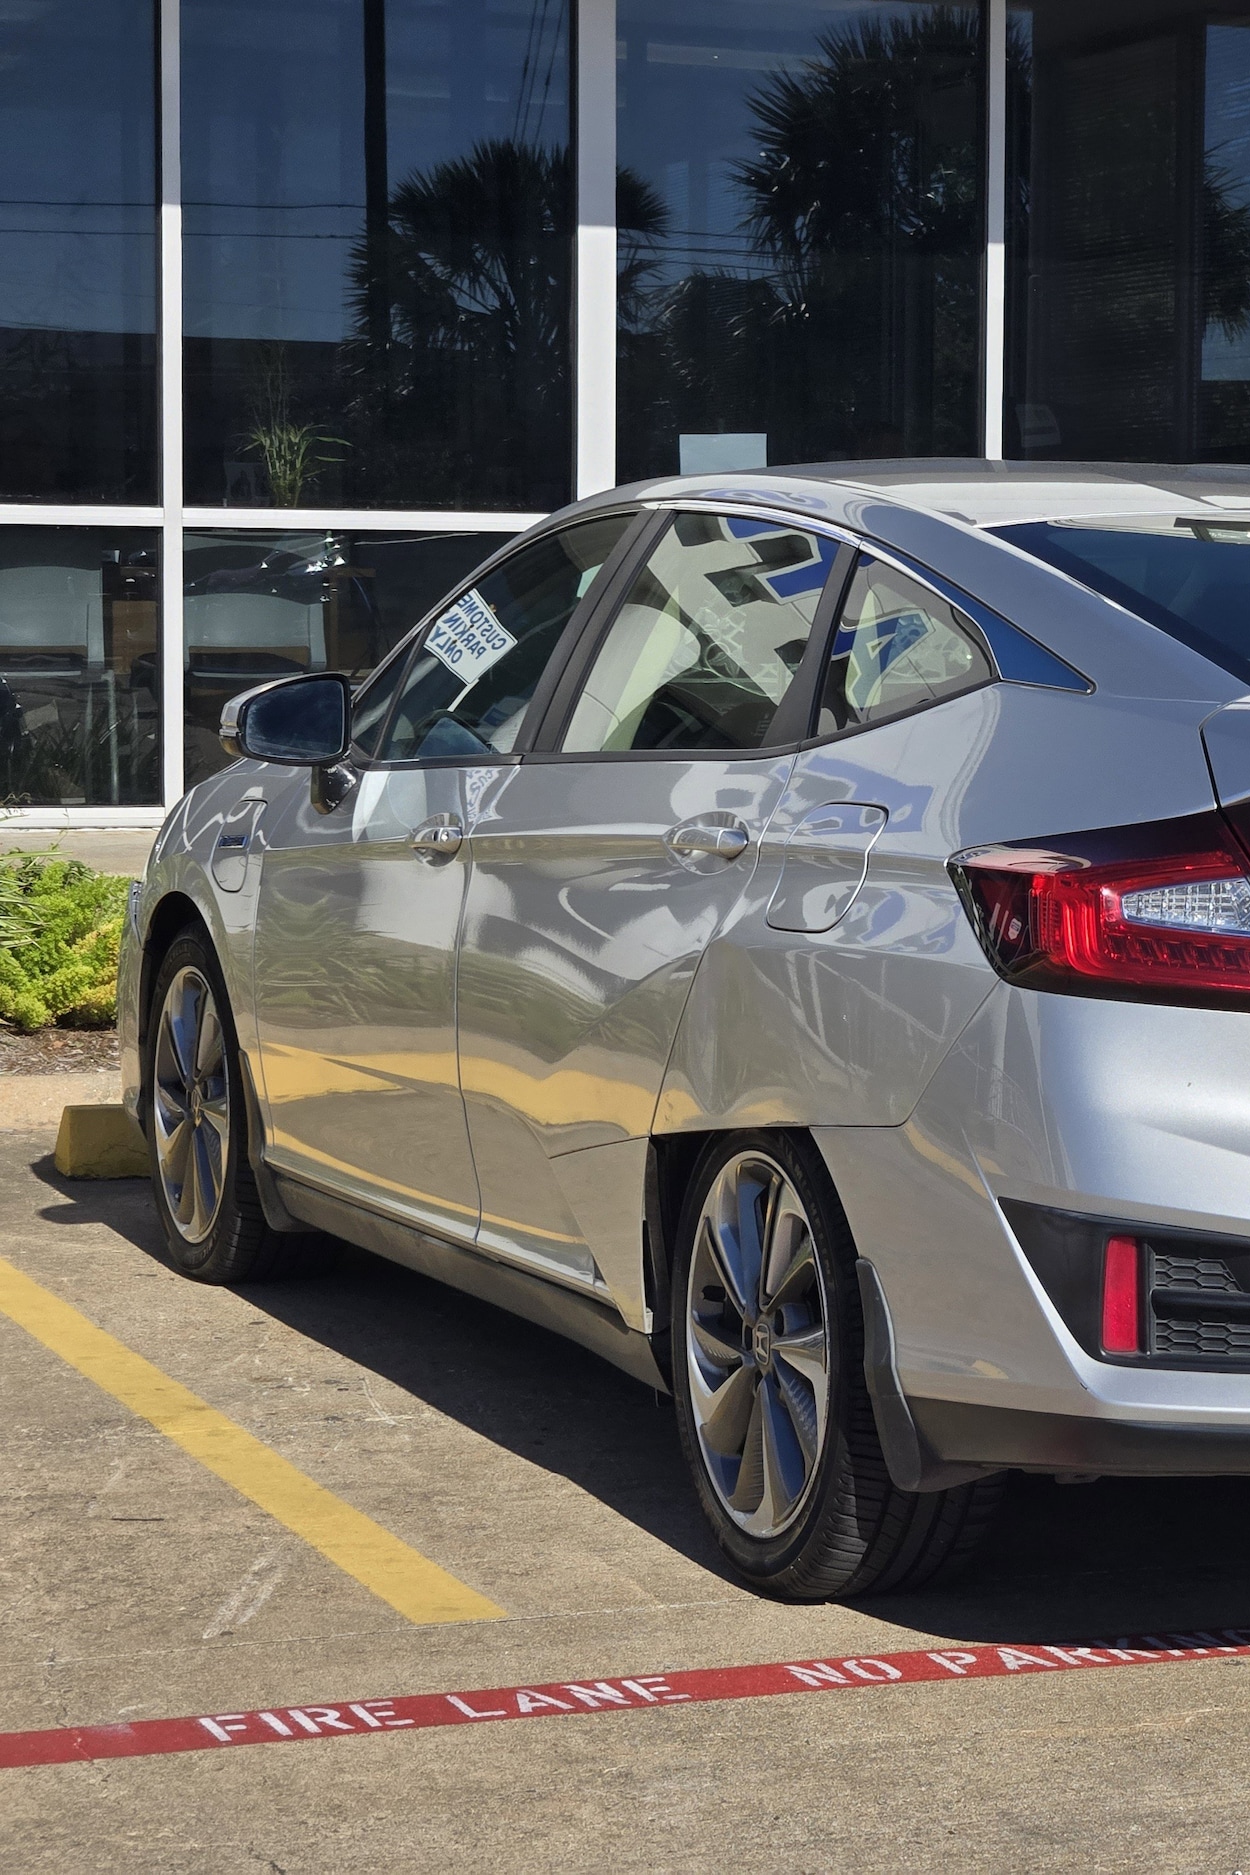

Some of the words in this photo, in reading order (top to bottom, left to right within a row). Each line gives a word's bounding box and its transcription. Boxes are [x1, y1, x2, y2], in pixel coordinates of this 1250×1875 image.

[198, 1700, 415, 1742] FIRE
[445, 1676, 693, 1718] LANE
[784, 1658, 903, 1687] NO
